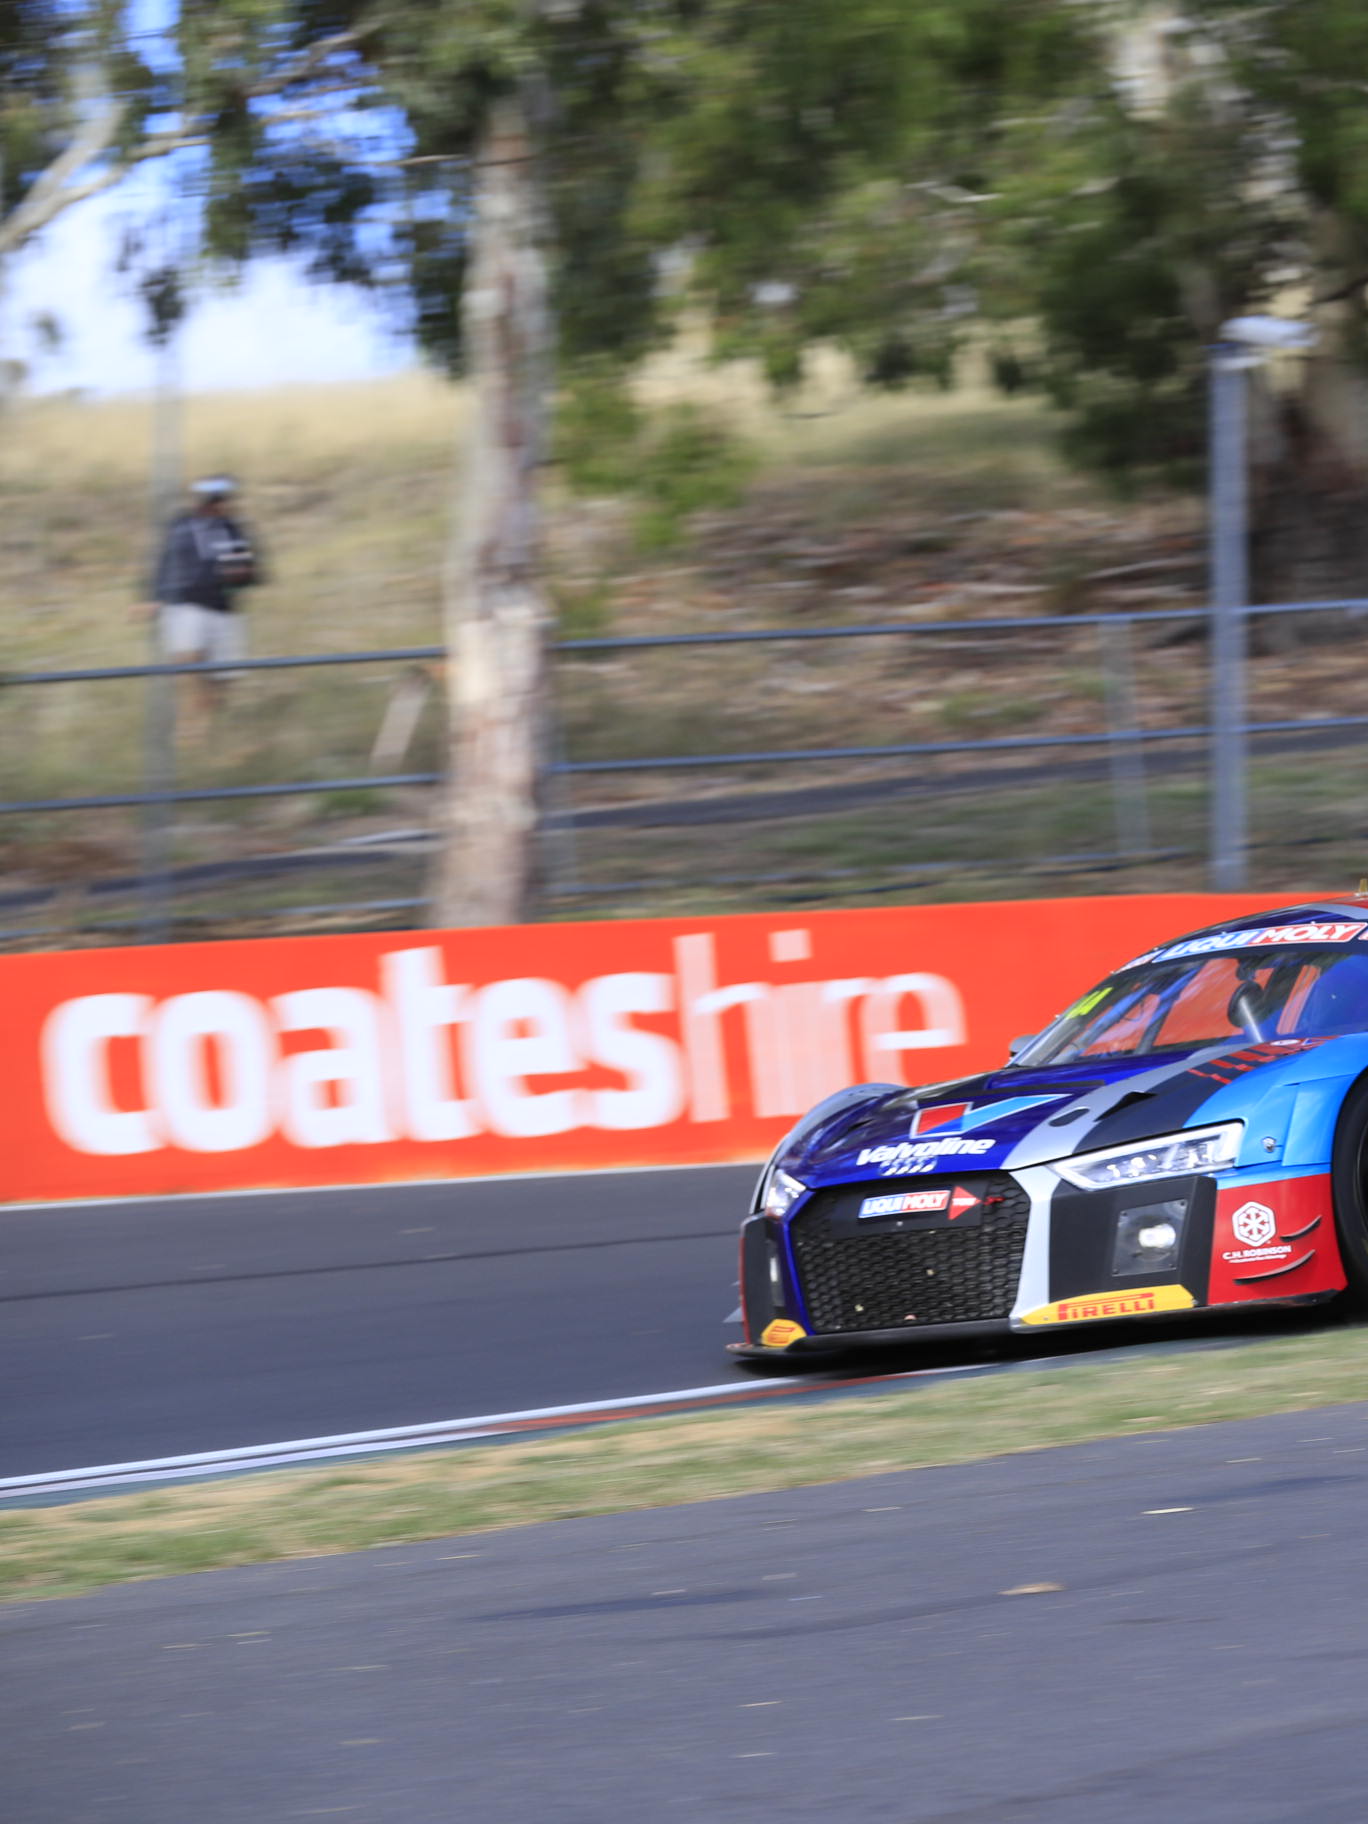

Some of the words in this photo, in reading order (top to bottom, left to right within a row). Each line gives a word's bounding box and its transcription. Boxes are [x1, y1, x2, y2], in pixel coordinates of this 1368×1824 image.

[1161, 930, 1260, 960] LIQUI
[1251, 924, 1352, 943] MOLY
[856, 1137, 996, 1166] Valvoline
[862, 1197, 903, 1215] LIQUI
[902, 1193, 947, 1211] MOLY
[1243, 1245, 1292, 1257] ROBINSON
[1058, 1292, 1155, 1321] PIRELLI
